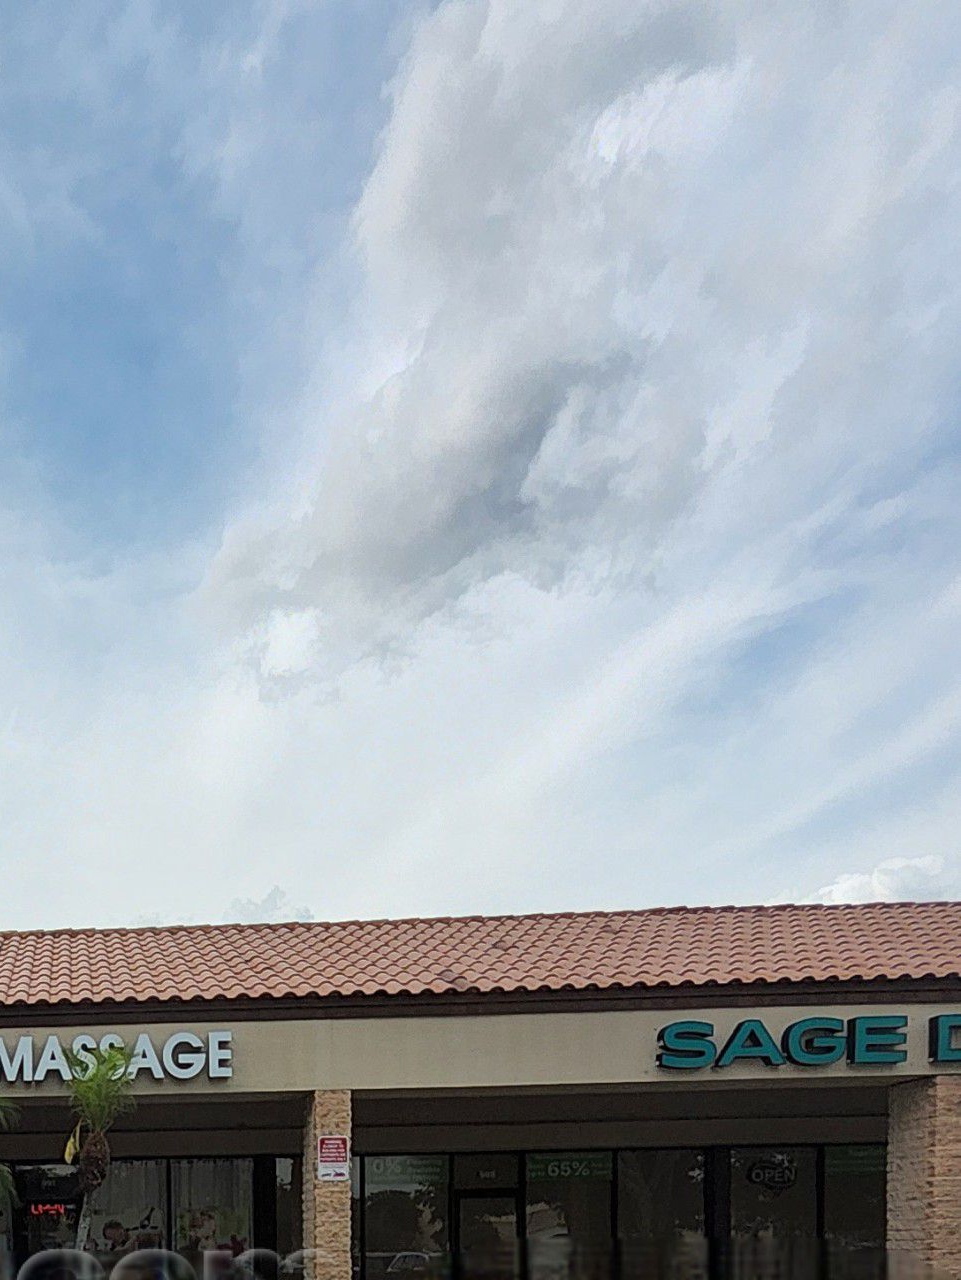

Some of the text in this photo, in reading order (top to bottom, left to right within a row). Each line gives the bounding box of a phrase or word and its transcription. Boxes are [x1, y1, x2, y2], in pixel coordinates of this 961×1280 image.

[656, 1016, 909, 1069] SAGE
[547, 1160, 590, 1177] 65%
[750, 1165, 796, 1183] OPEN
